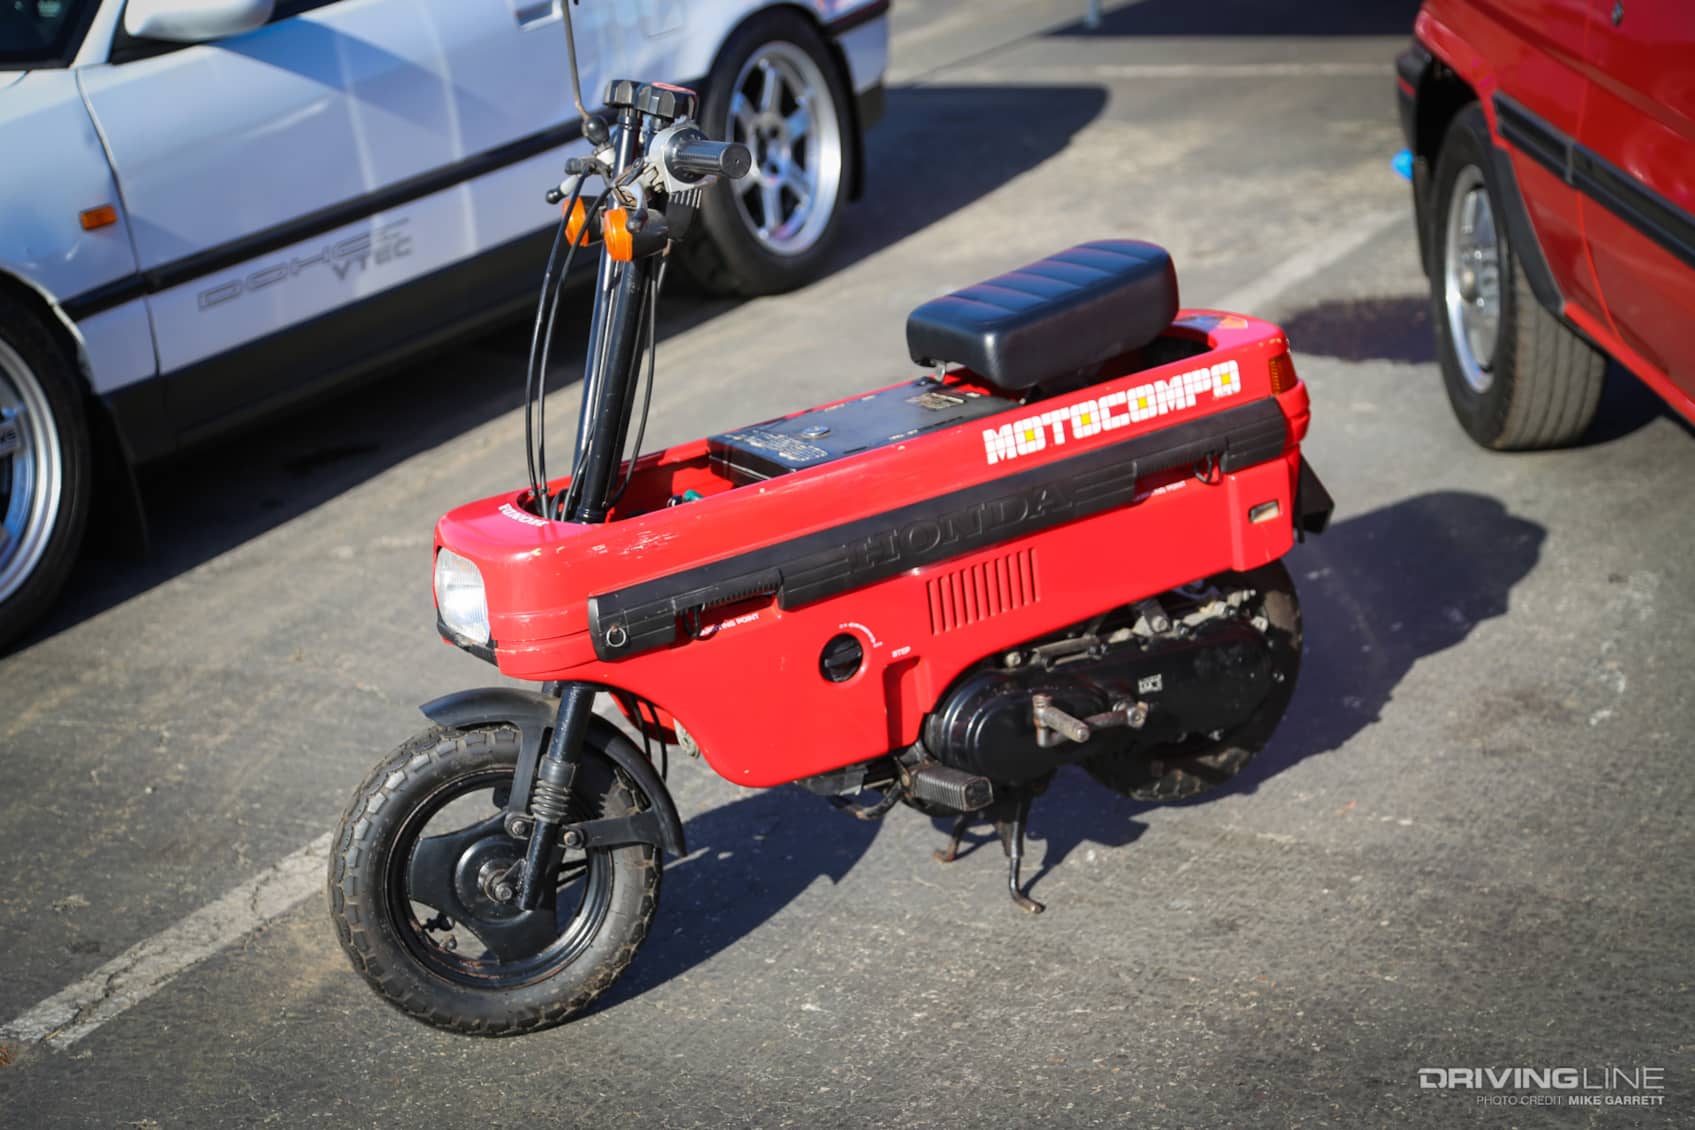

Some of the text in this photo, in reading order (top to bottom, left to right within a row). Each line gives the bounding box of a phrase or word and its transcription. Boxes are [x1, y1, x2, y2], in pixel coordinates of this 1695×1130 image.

[332, 235, 412, 281] VTEC
[982, 360, 1241, 465] MOTOCOMPO
[855, 483, 1073, 573] HONDA
